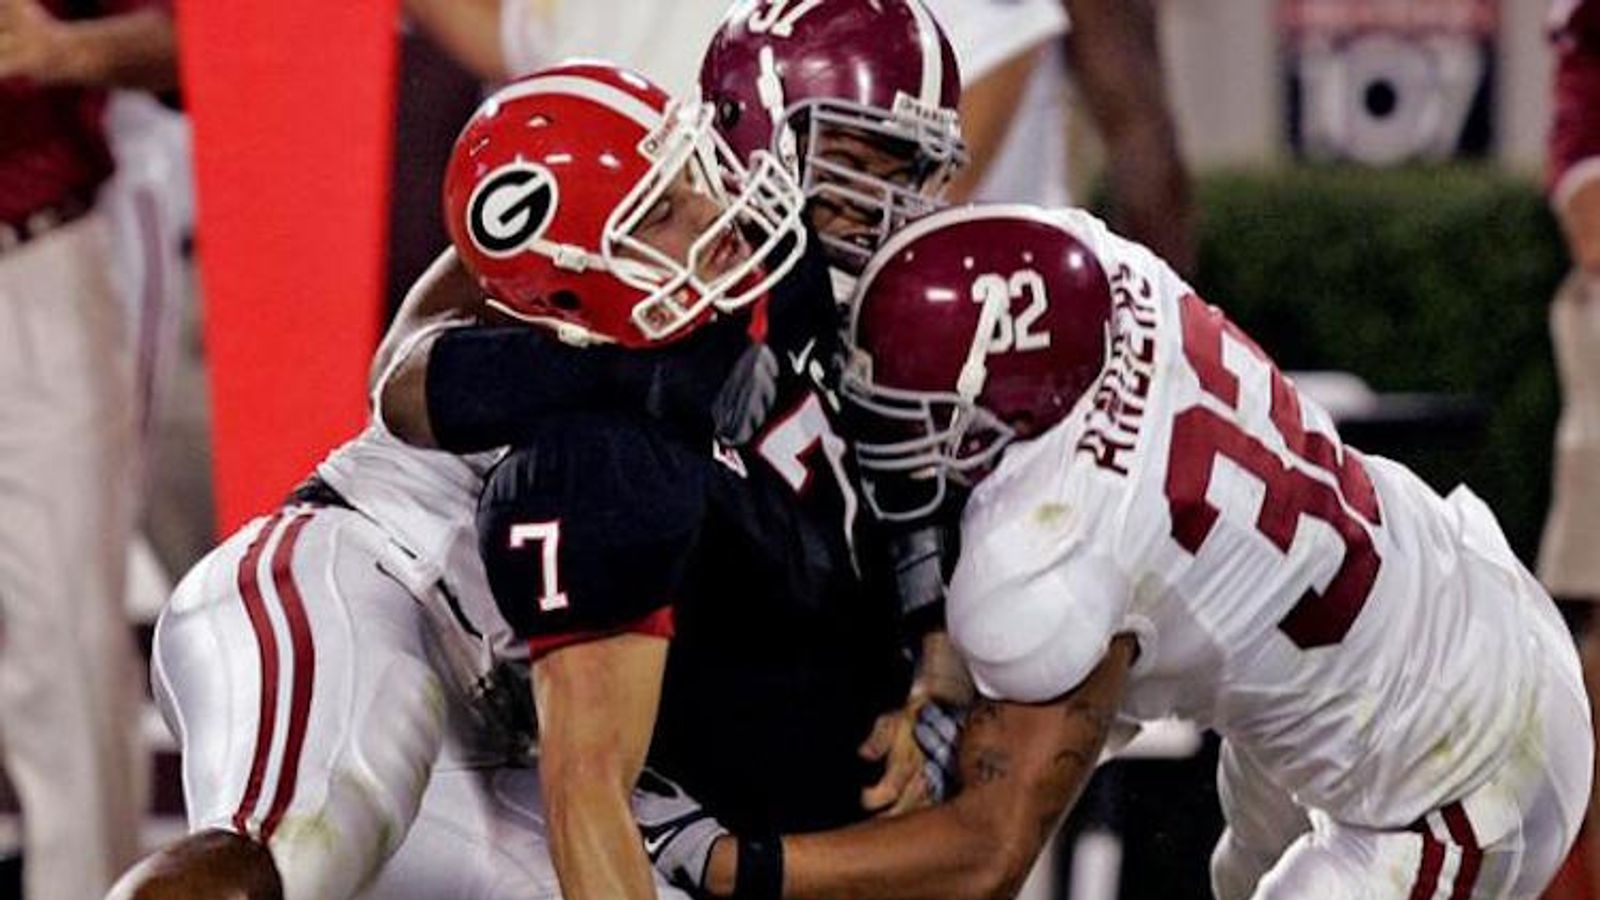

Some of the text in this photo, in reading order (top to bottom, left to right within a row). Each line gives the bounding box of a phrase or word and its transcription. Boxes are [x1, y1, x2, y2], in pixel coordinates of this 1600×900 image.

[467, 164, 556, 256] G
[972, 269, 1050, 353] 32
[757, 390, 861, 578] 7
[1163, 292, 1382, 651] 32
[509, 520, 569, 611] 7
